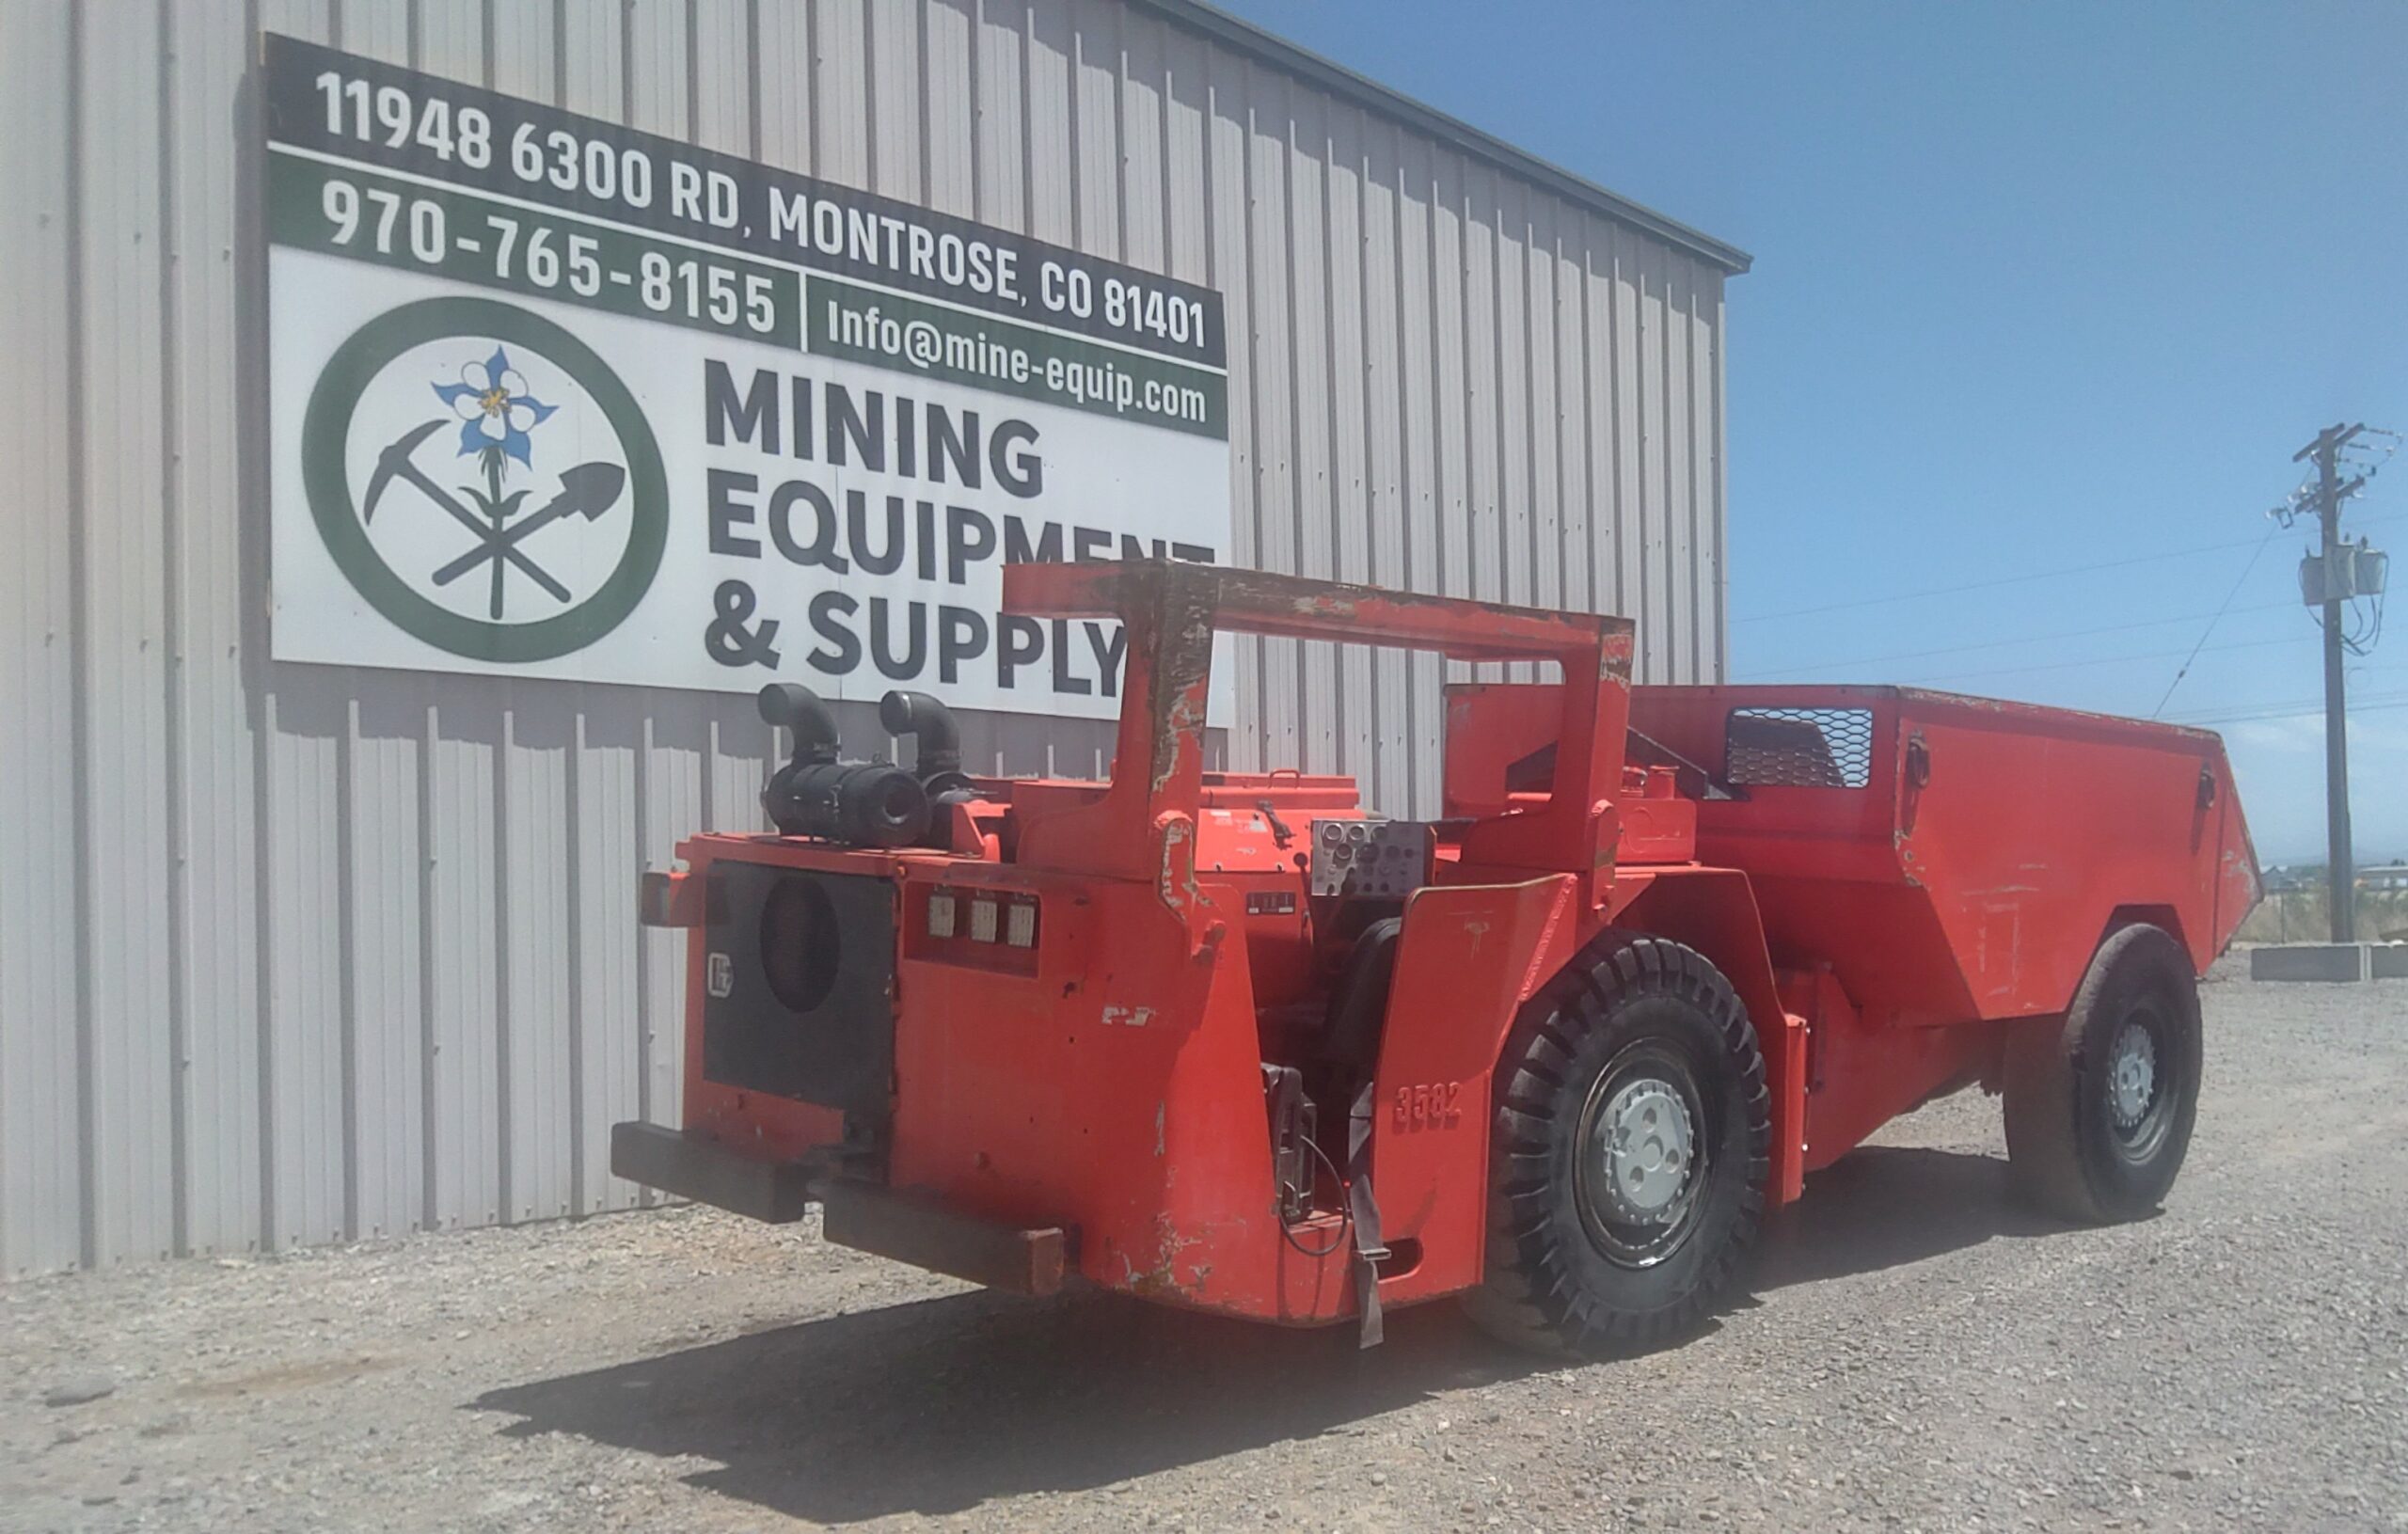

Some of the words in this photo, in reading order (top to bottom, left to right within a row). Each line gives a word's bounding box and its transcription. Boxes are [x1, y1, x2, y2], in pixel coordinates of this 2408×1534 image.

[316, 71, 492, 170] 11948
[511, 122, 652, 209] 6300
[671, 161, 752, 238] RD,
[768, 186, 1028, 308] MONTROSE,
[1041, 261, 1092, 318] CO
[1105, 279, 1205, 348] 81401
[322, 180, 775, 333] 970-765-8155
[828, 300, 1207, 423] Info@mine-equip.com
[704, 358, 1044, 499] MINING
[705, 579, 782, 671] &
[805, 590, 1128, 698] SUPPLY
[1394, 1081, 1462, 1123] 3582
